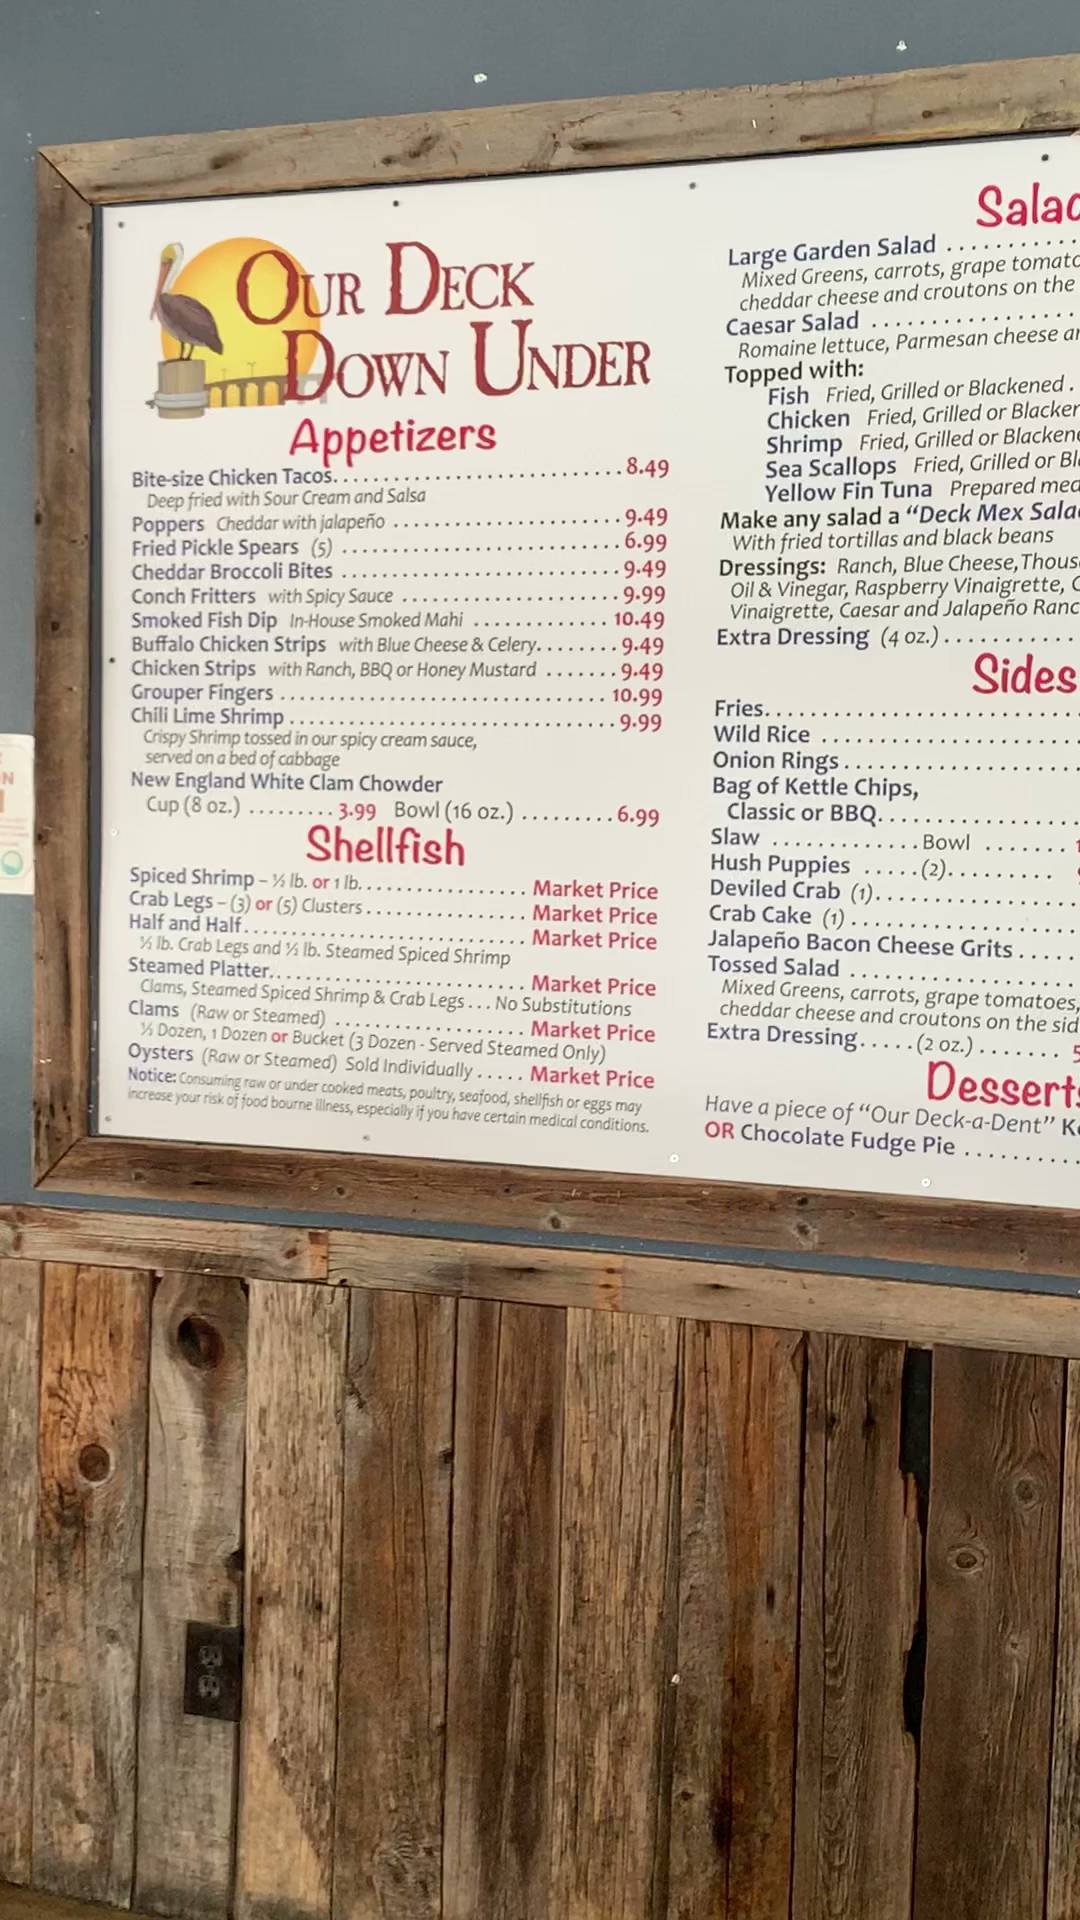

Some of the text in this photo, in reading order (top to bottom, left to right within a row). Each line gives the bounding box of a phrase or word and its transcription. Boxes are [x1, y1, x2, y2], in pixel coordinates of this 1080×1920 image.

[728, 233, 936, 270] Large Garden Salad
[740, 274, 1075, 312] cheddar cheese and croutons on the
[726, 310, 859, 336] Caesar Salad
[724, 358, 864, 388] Topped with:
[768, 374, 1064, 406] Fish Fried, Grilled or Blackened
[288, 418, 497, 468] Appetizers
[132, 470, 204, 488] Bite-size
[208, 468, 278, 486] Chicken
[626, 456, 669, 478] 8.49
[132, 508, 668, 537] Poppers Cheddar with jalapeño 9.49
[132, 531, 667, 560] Fried Pickle Spears (5) 6.99
[733, 526, 1054, 554] With fried tortillas and black beans
[131, 560, 666, 580] Cheddar Broccoli Bites 9.49
[131, 585, 666, 608] Conch Fritters with Spicy Sauce 9.99
[131, 610, 665, 634] Smoked Fish Dip In-House Smoked Mahi 10.49
[717, 625, 938, 650] Extra Dressing (4 oz.)
[131, 658, 664, 682] Chicken Strips with Ranch, BBQ or Honey Mustard 9.49
[972, 652, 1078, 695] Sides
[131, 683, 662, 707] Grouper Fingers 10.99
[130, 706, 662, 732] Chili Lime Shrimp 9.99
[713, 724, 810, 744] Wild Rice
[713, 750, 839, 776] Onion Rings
[131, 771, 444, 794] New England White Clam Chowder
[146, 795, 660, 828] Cup (8 oz.) 3.99 Bowl (16 oz.) 6.99
[306, 824, 465, 867] Shellfish
[711, 852, 946, 882] Hush Puppies (2)
[710, 878, 872, 905] Deviled Crab (1)
[129, 890, 169, 907] Crab
[174, 892, 213, 914] Legs
[230, 894, 251, 914] (3)
[255, 900, 273, 911] or
[277, 896, 298, 916] (5)
[302, 898, 362, 914] Clusters
[532, 904, 603, 923] Market
[609, 906, 658, 925] Price
[707, 928, 1012, 958] Jalapeño Bacon Cheese Grits
[128, 956, 204, 975] Steamed
[532, 974, 602, 994] Market
[608, 978, 656, 996] Price
[128, 1042, 194, 1063] Oysters
[202, 1048, 240, 1066] (Raw
[244, 1054, 261, 1065] or
[264, 1052, 337, 1074] Steamed)
[345, 1056, 380, 1072] Sold
[530, 1065, 600, 1086] Market
[606, 1070, 655, 1089] Price
[128, 1088, 648, 1133] increase your risk of food bourne illness, especially if you have certain medical conditions.
[704, 1120, 955, 1157] OR Chocolate Fudge Pie
